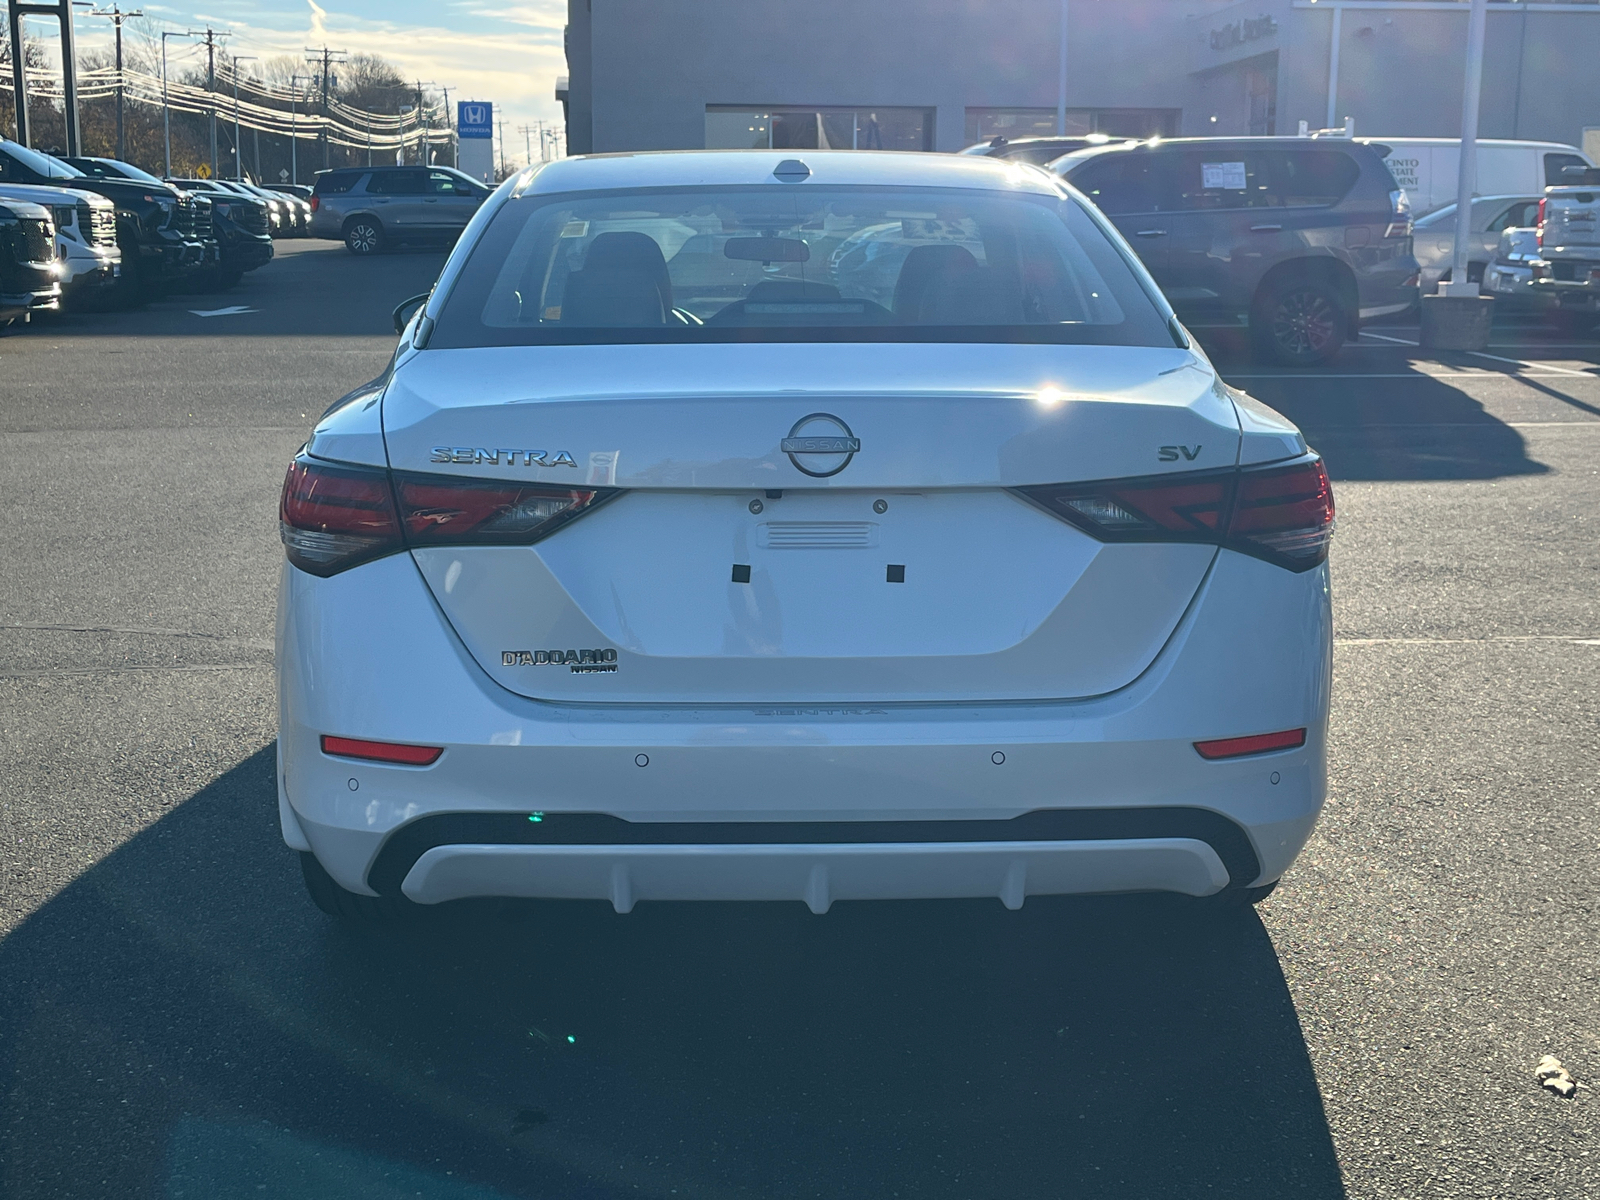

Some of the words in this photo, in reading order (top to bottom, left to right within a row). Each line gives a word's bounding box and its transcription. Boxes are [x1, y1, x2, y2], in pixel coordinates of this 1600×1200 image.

[784, 440, 858, 450] NISSAN
[1158, 445, 1202, 461] SV
[430, 446, 578, 468] SENTRA
[501, 648, 618, 667] D'ADDARIO
[570, 664, 618, 674] NISSAN
